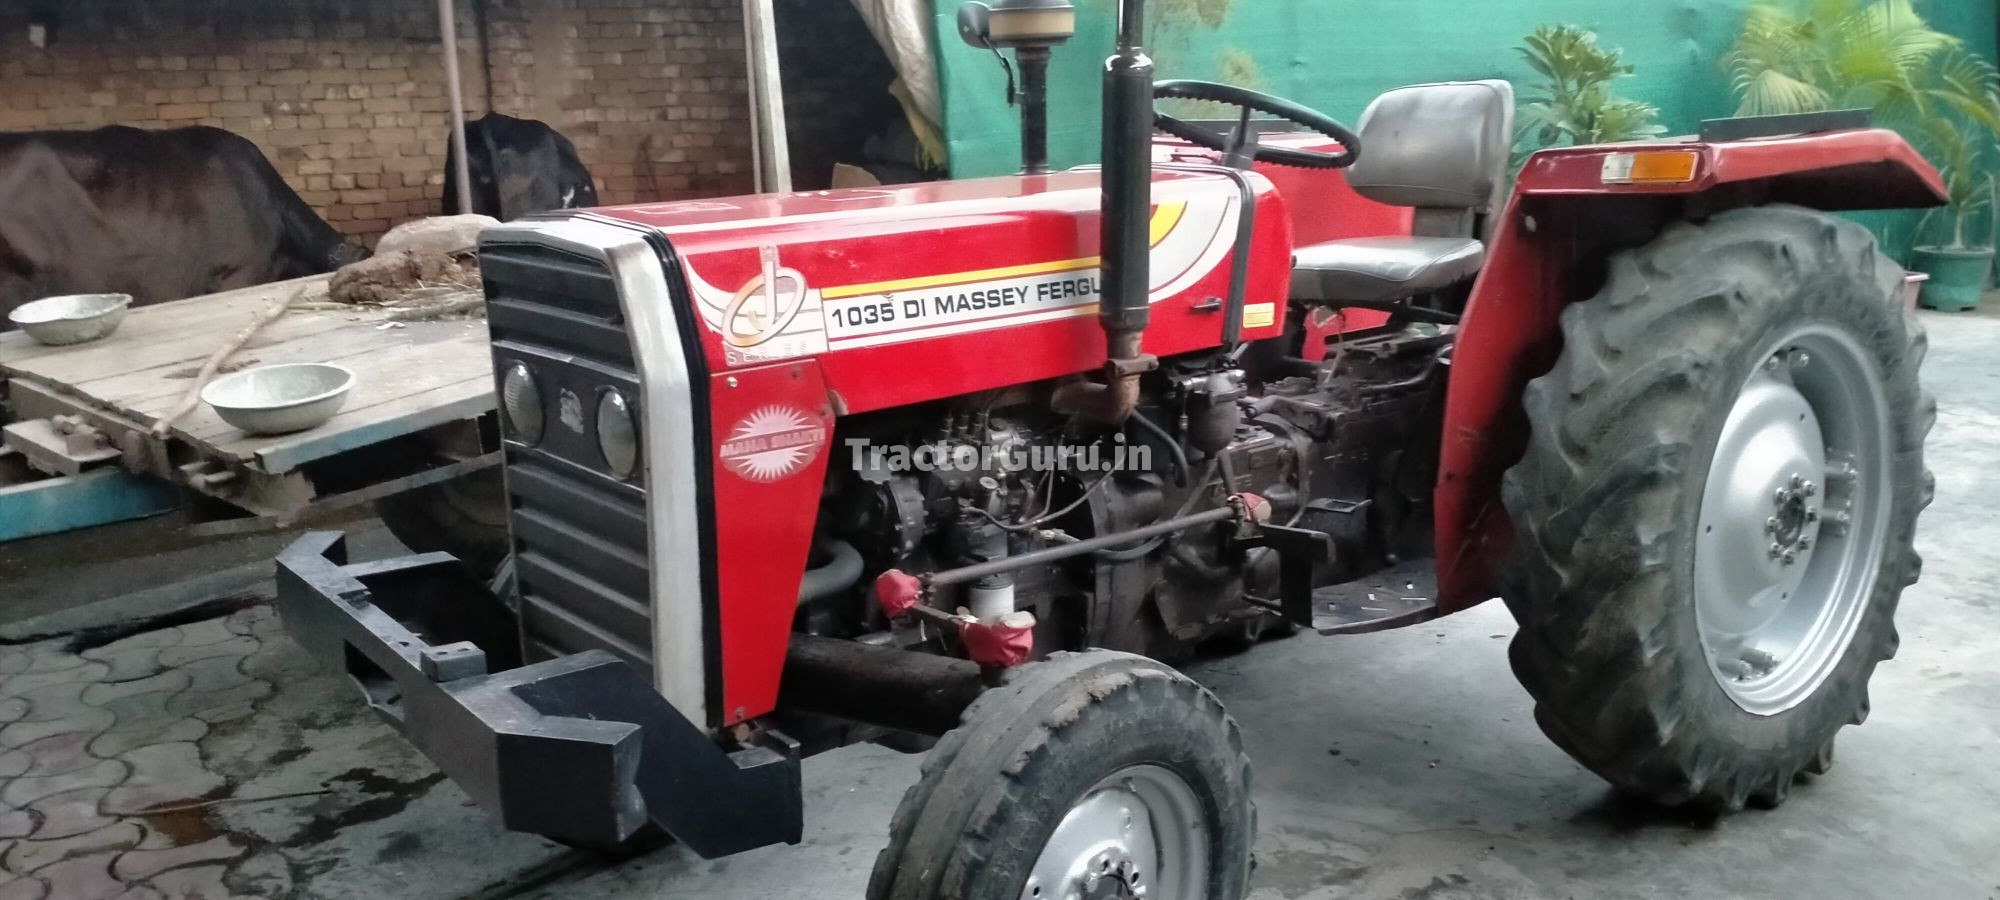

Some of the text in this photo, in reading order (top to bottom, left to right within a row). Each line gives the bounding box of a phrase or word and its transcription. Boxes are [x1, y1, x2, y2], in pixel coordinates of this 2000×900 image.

[832, 302, 895, 328] 1035
[903, 298, 927, 320] DI
[935, 285, 1028, 315] MASSEY
[720, 438, 768, 457] MAHA
